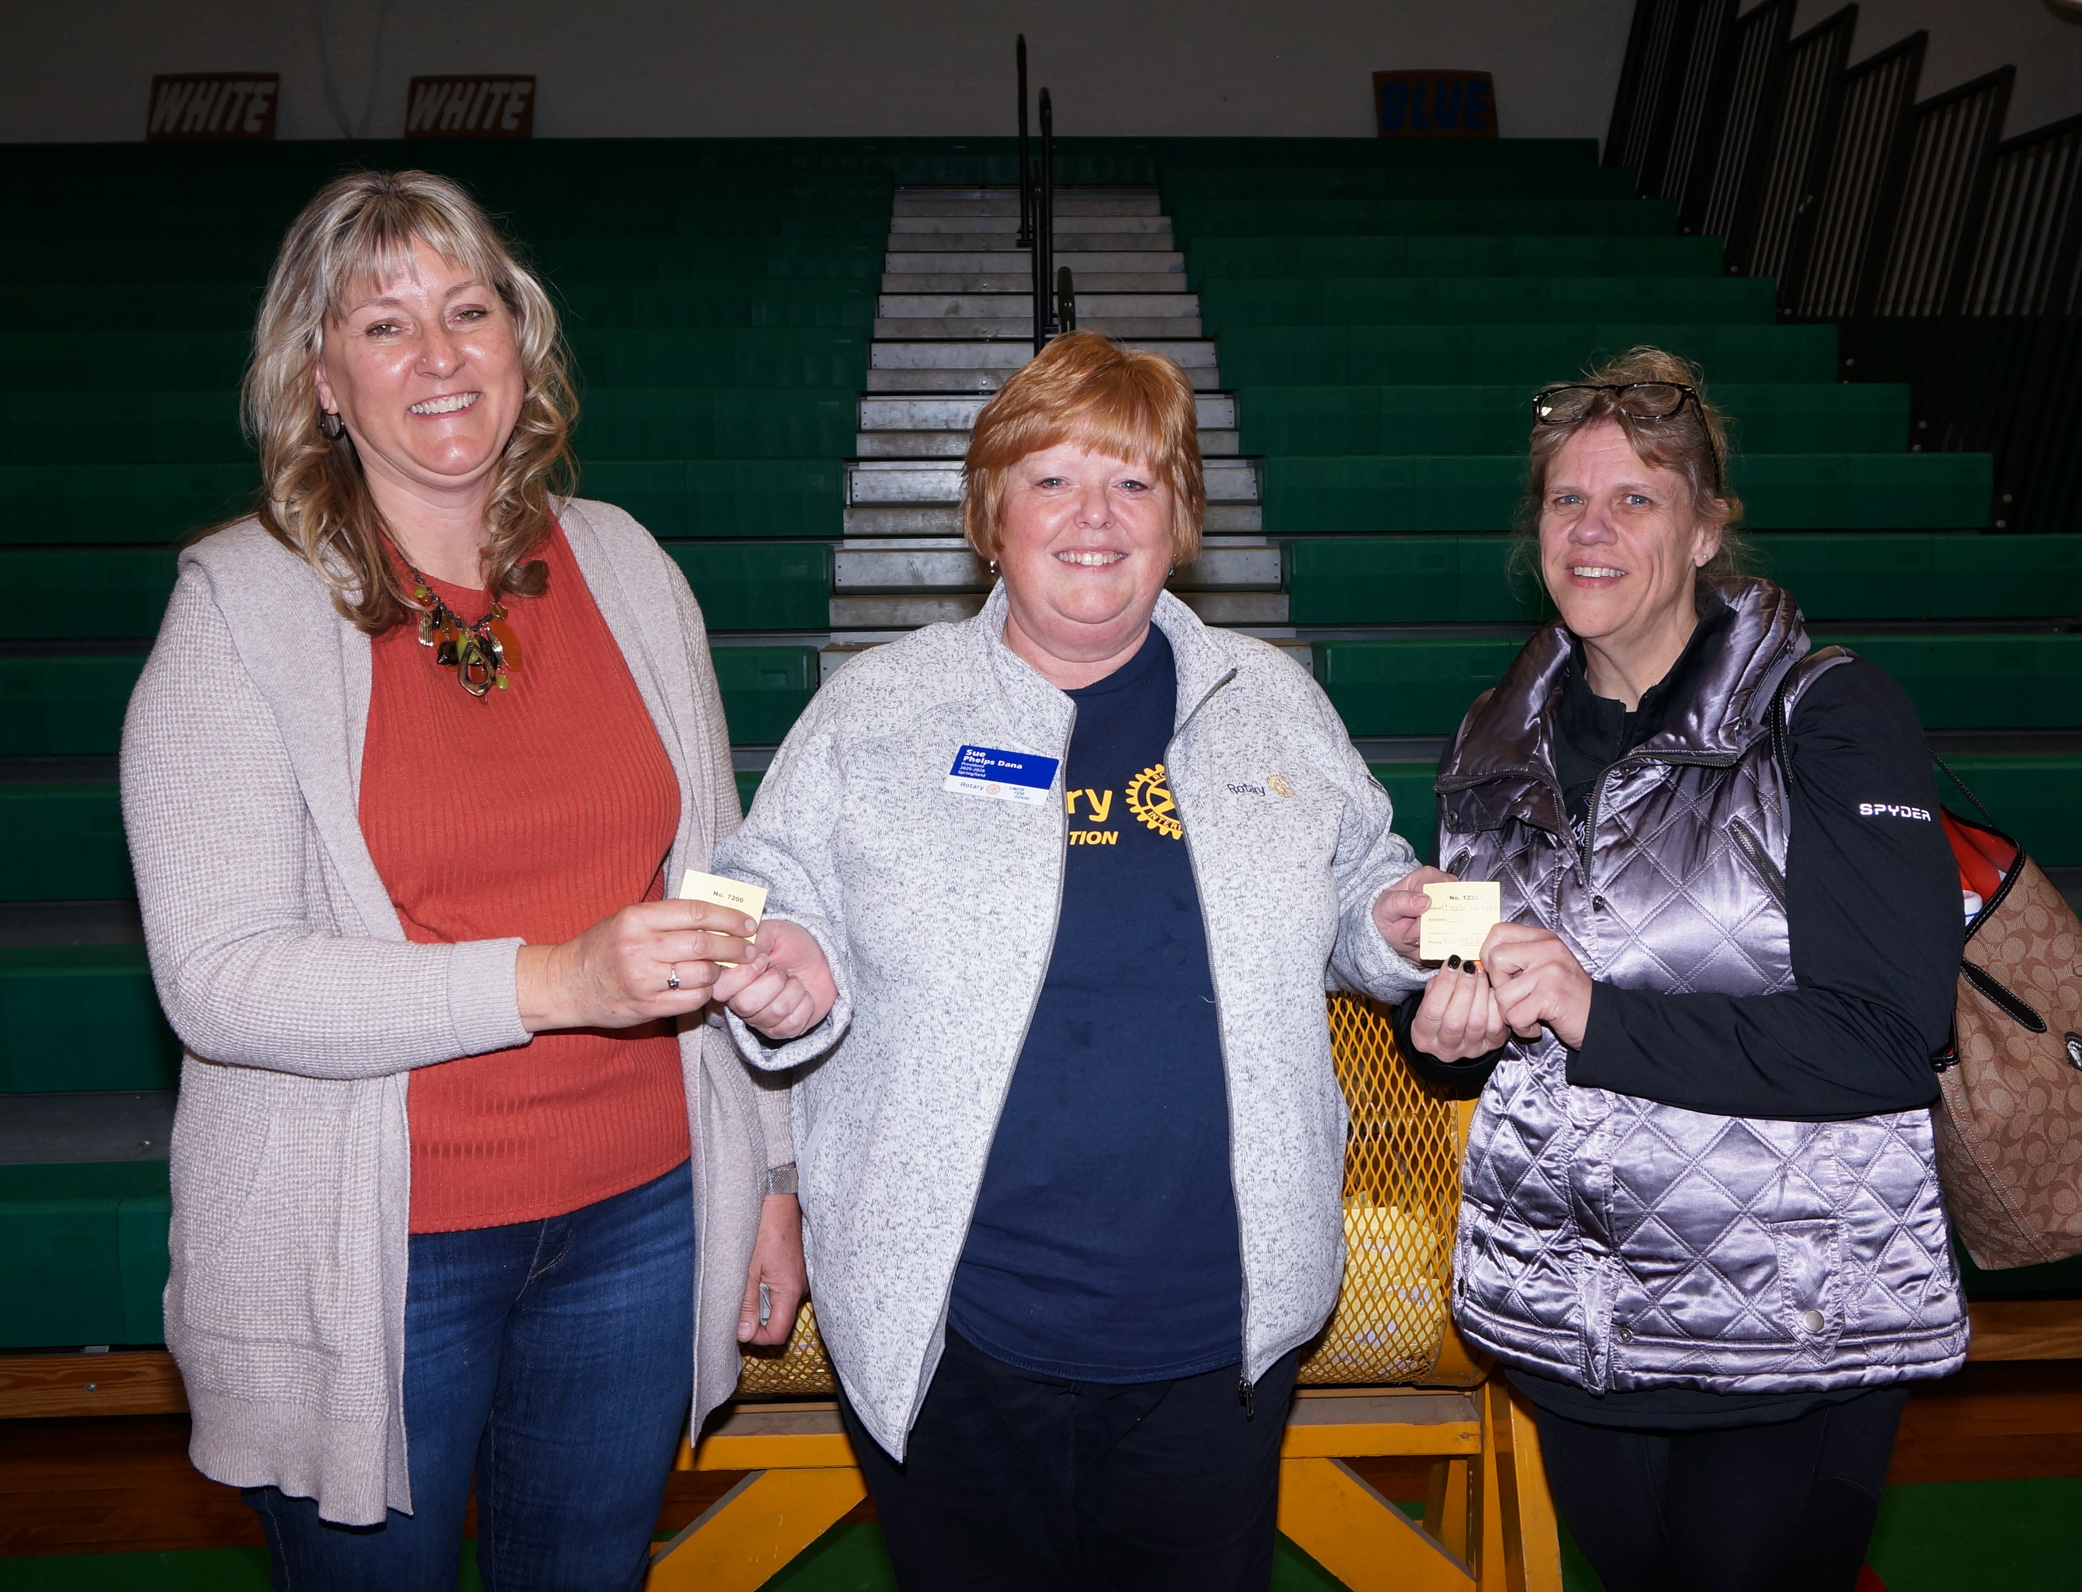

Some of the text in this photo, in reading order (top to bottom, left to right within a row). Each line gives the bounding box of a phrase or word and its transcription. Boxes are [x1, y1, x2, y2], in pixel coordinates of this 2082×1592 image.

[150, 81, 276, 134] WHITE
[407, 81, 533, 131] WHITE
[1381, 80, 1489, 133] BLUE
[965, 749, 986, 757] Sue
[963, 755, 1023, 770] Phelps Dana
[960, 781, 985, 791] Rotary
[1227, 783, 1266, 797] Rotary
[1859, 803, 1932, 822] SPYDER
[1069, 831, 1119, 845] TION
[713, 890, 725, 899] No.
